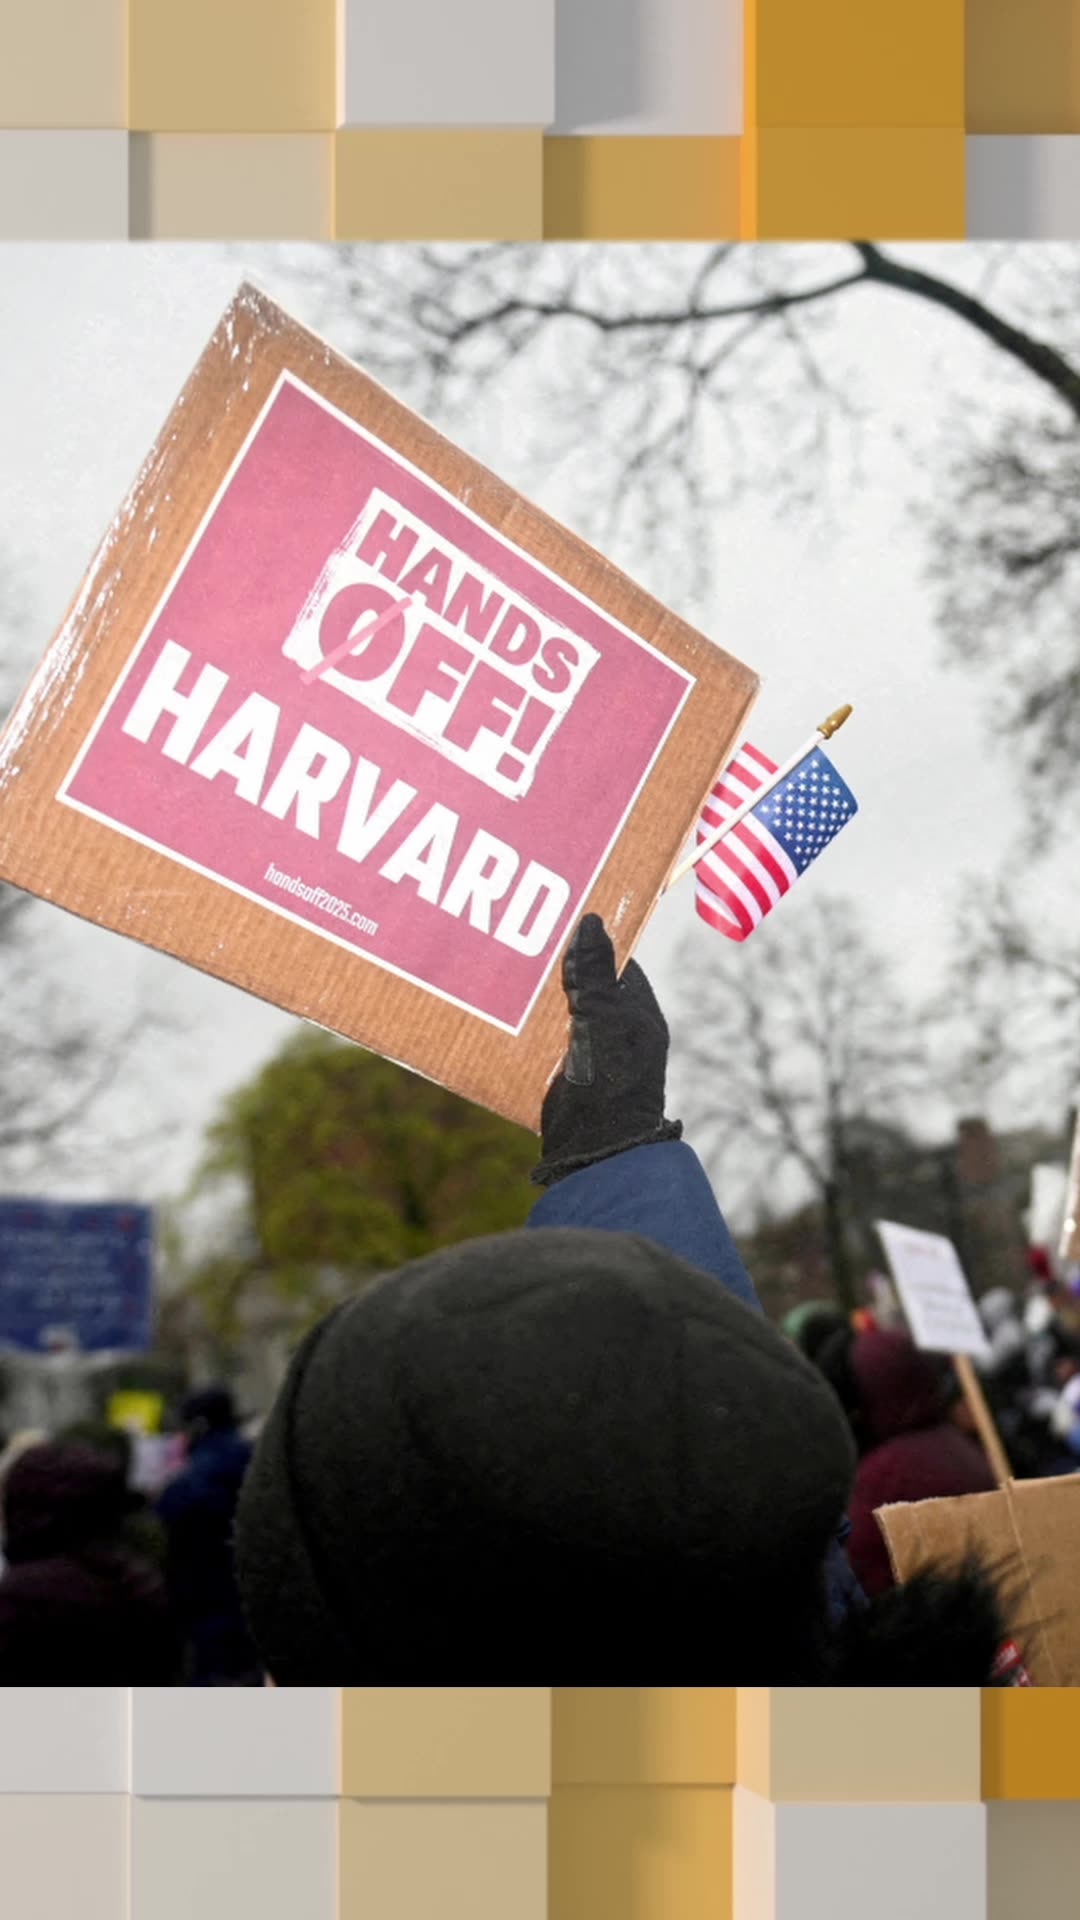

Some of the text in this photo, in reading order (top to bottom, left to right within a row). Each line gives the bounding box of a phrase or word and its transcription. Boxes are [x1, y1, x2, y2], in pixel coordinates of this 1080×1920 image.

[355, 508, 580, 694] HANDS
[121, 638, 571, 958] HARVARD
[263, 862, 379, 936] handsoff2025.com
